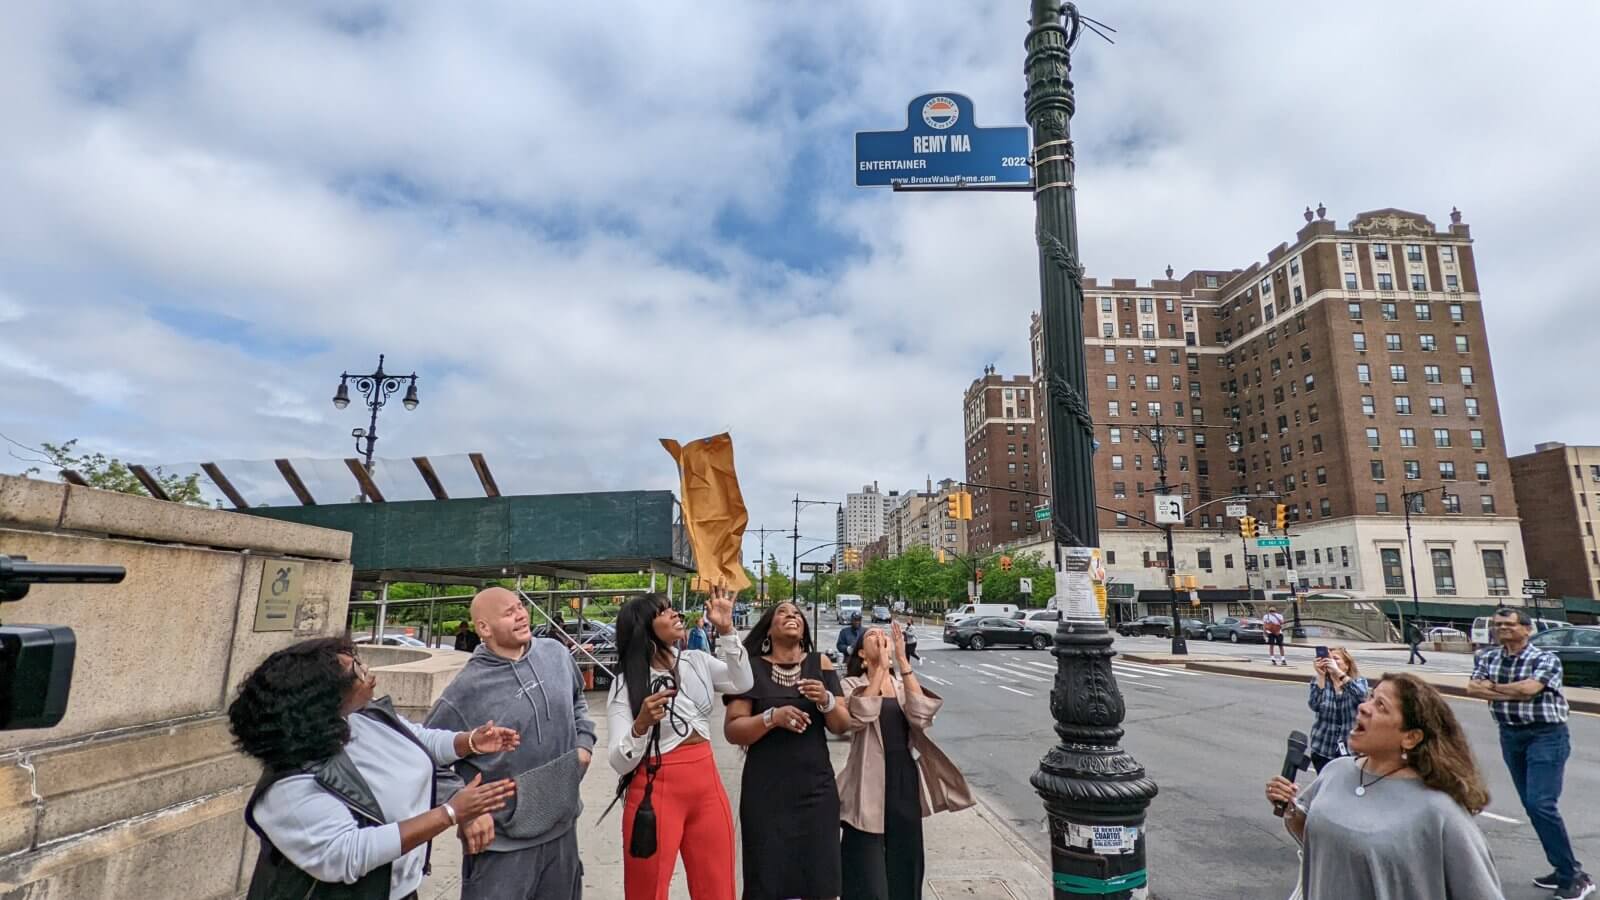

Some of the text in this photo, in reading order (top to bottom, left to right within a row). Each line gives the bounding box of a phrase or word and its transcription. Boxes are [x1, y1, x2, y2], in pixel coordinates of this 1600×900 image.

[913, 134, 971, 153] REMY MA
[859, 159, 927, 171] ENTERTAINER
[1001, 156, 1027, 168] 2022
